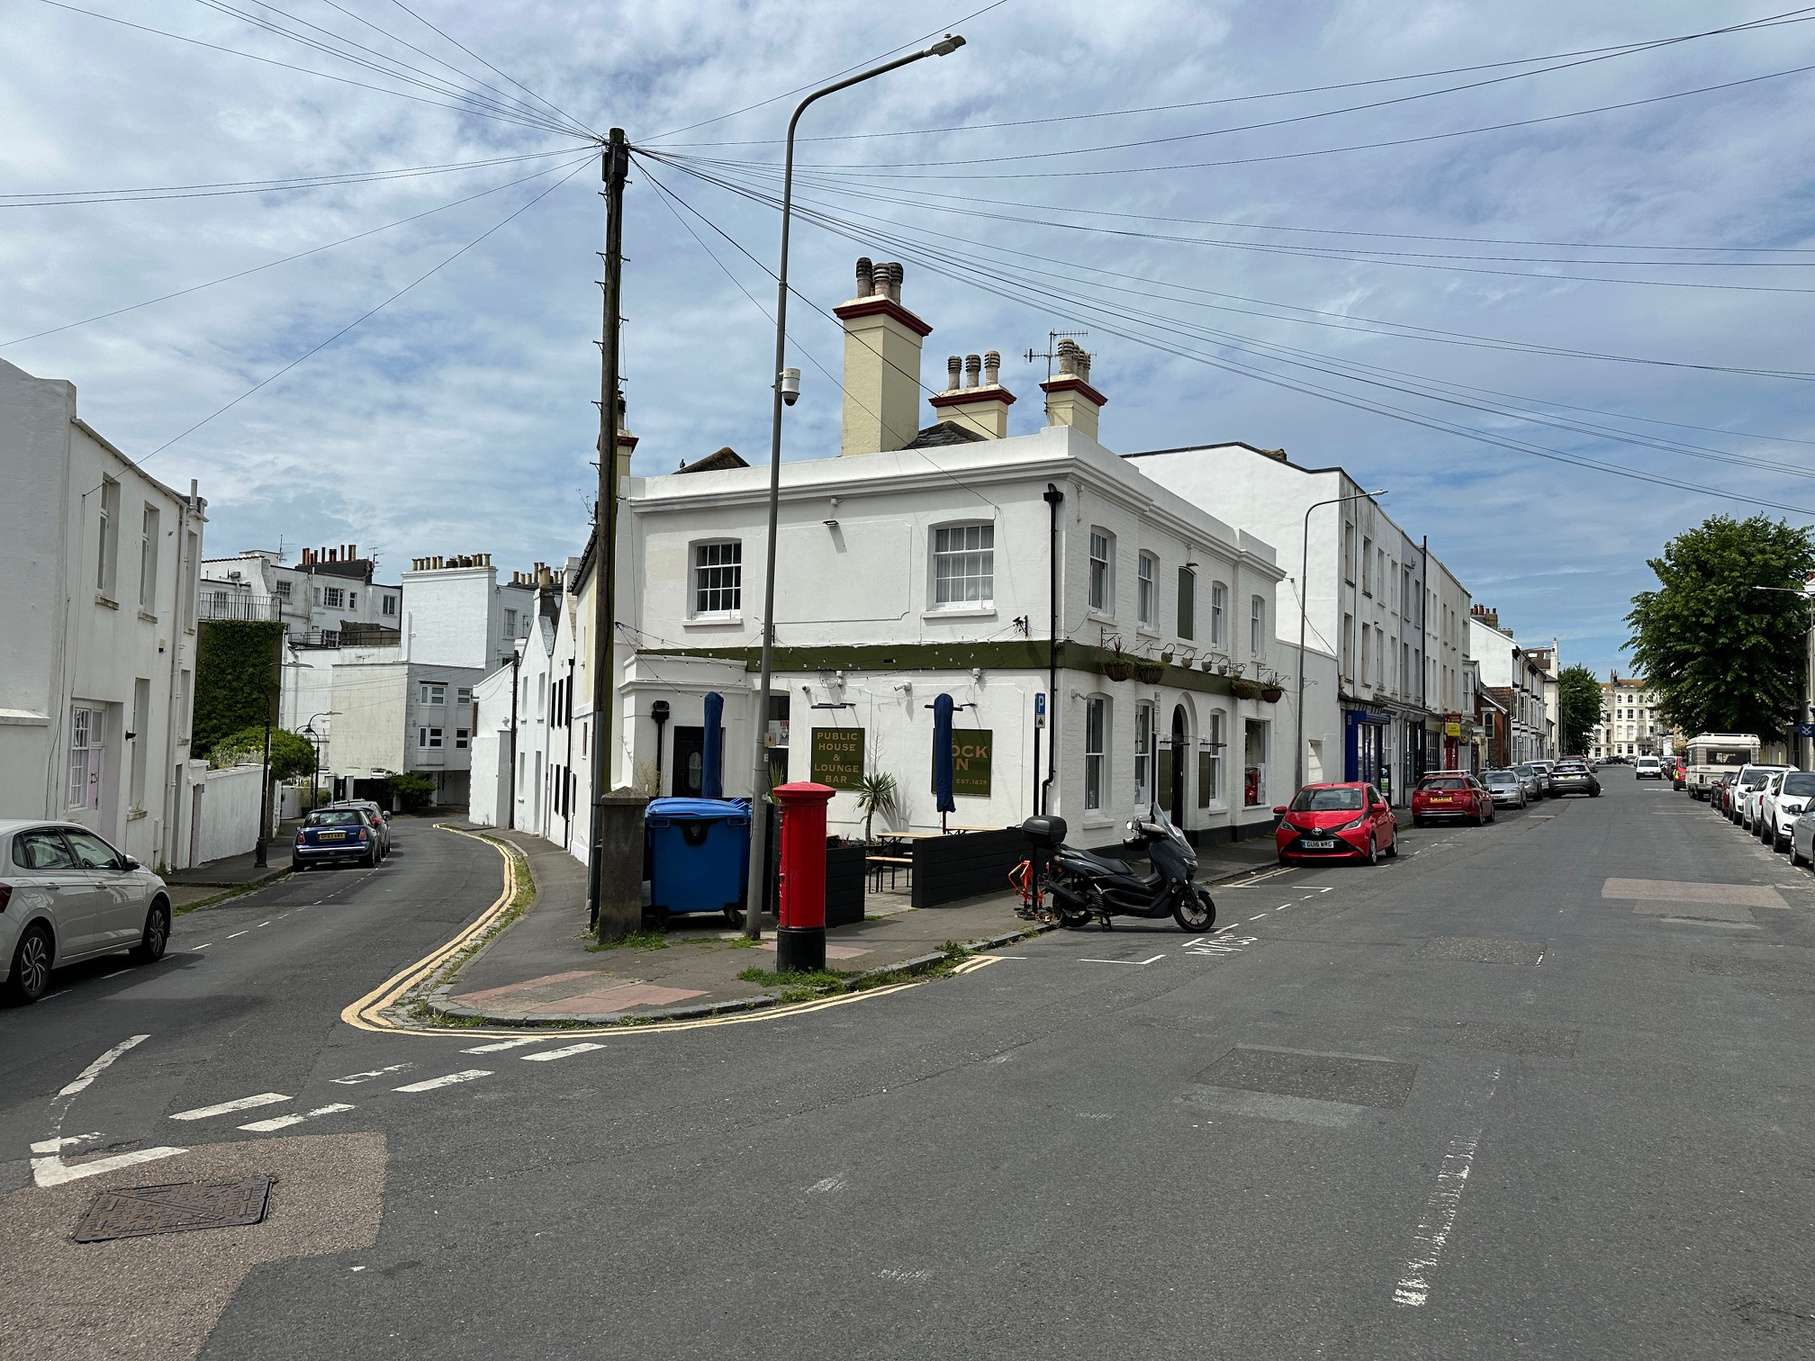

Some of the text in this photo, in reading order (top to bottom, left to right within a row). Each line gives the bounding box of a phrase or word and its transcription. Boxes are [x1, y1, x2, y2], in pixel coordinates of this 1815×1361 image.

[1038, 695, 1045, 713] P
[816, 732, 858, 741] PUBLIC
[818, 743, 857, 752] HOUSE
[951, 744, 988, 759] OCK
[832, 753, 841, 762] &
[814, 763, 860, 773] LOUNGE
[825, 774, 848, 784] BAR
